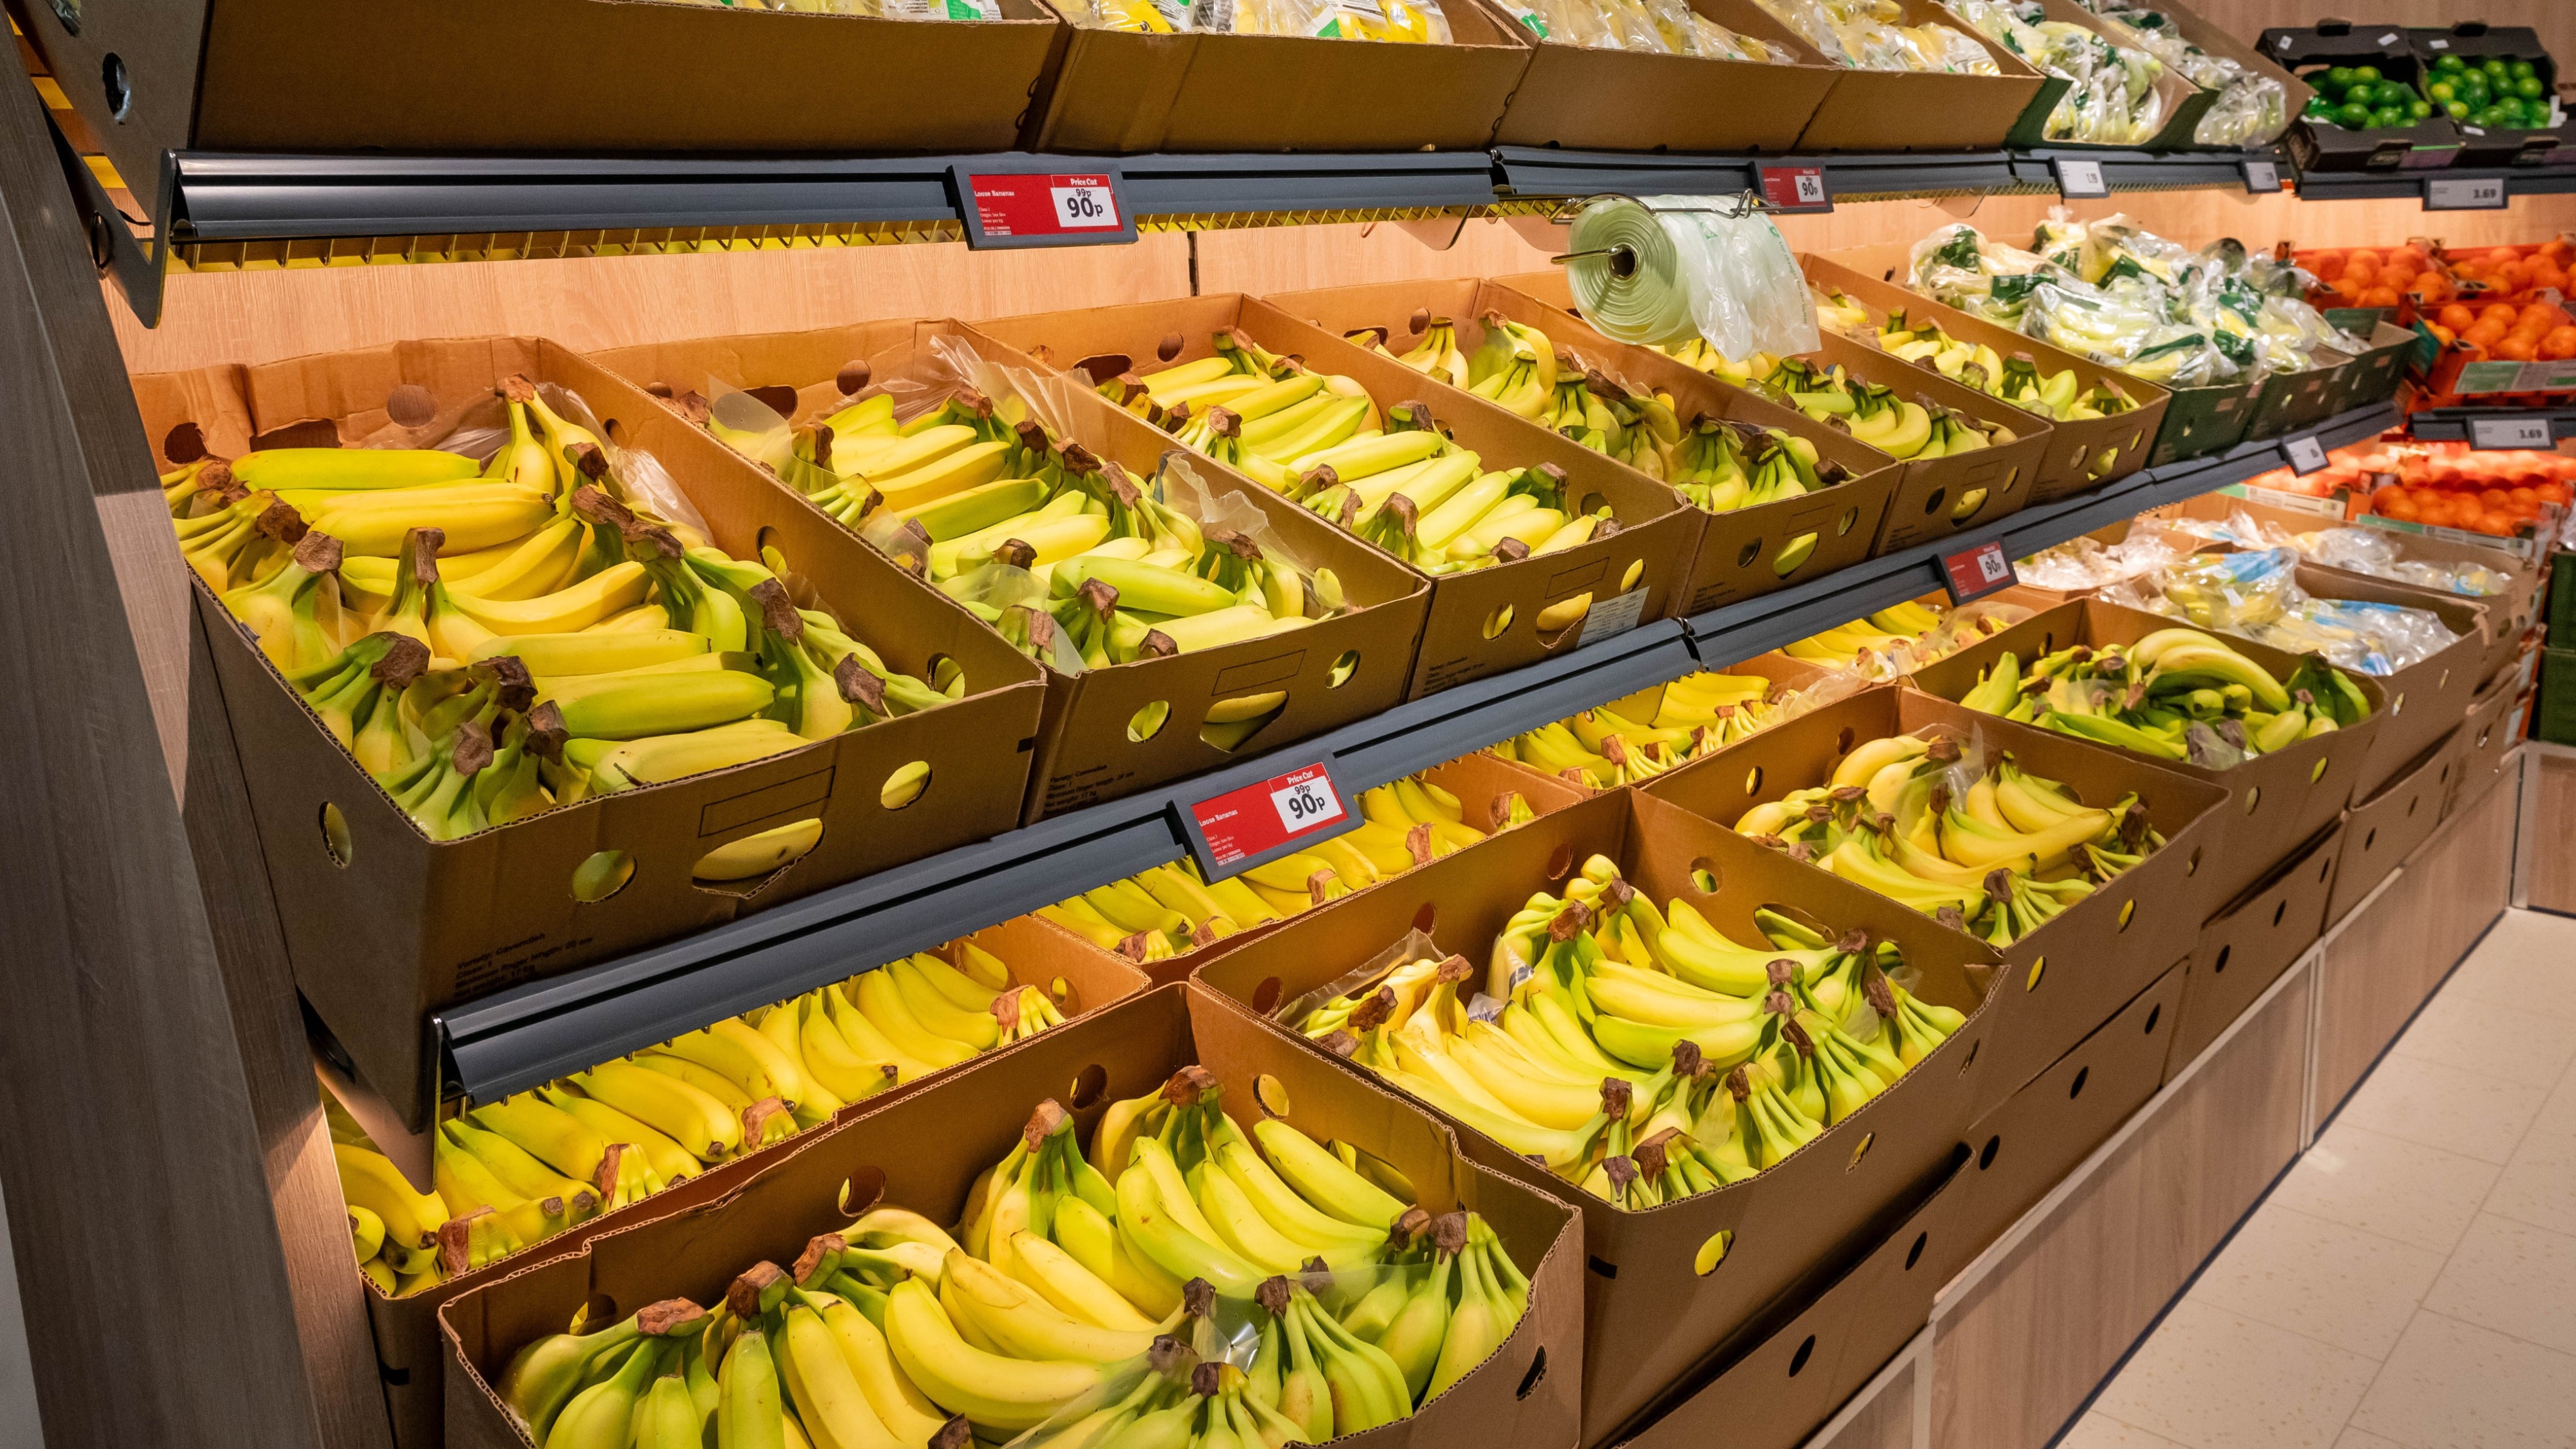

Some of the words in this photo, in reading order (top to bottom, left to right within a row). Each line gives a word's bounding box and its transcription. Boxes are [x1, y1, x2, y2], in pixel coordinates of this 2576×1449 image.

[1076, 189, 1091, 198] 99p
[1802, 182, 1818, 196] 90p
[1067, 197, 1103, 218] 90p
[1985, 560, 2001, 575] 90p
[1287, 775, 1303, 785] Price
[1302, 770, 1314, 779] Cut
[1294, 785, 1311, 794] 99p
[1289, 794, 1325, 819] 90p
[1199, 818, 1215, 826] Loose
[1215, 810, 1238, 821] Bananas
[457, 953, 492, 970] Variety:
[496, 933, 546, 955] Cavendish
[455, 969, 498, 989] Minimum
[501, 958, 528, 972] finger
[531, 946, 563, 960] length:
[566, 941, 576, 949] 20
[579, 937, 593, 945] cm
[523, 965, 535, 973] kg
[457, 964, 485, 979] Class:
